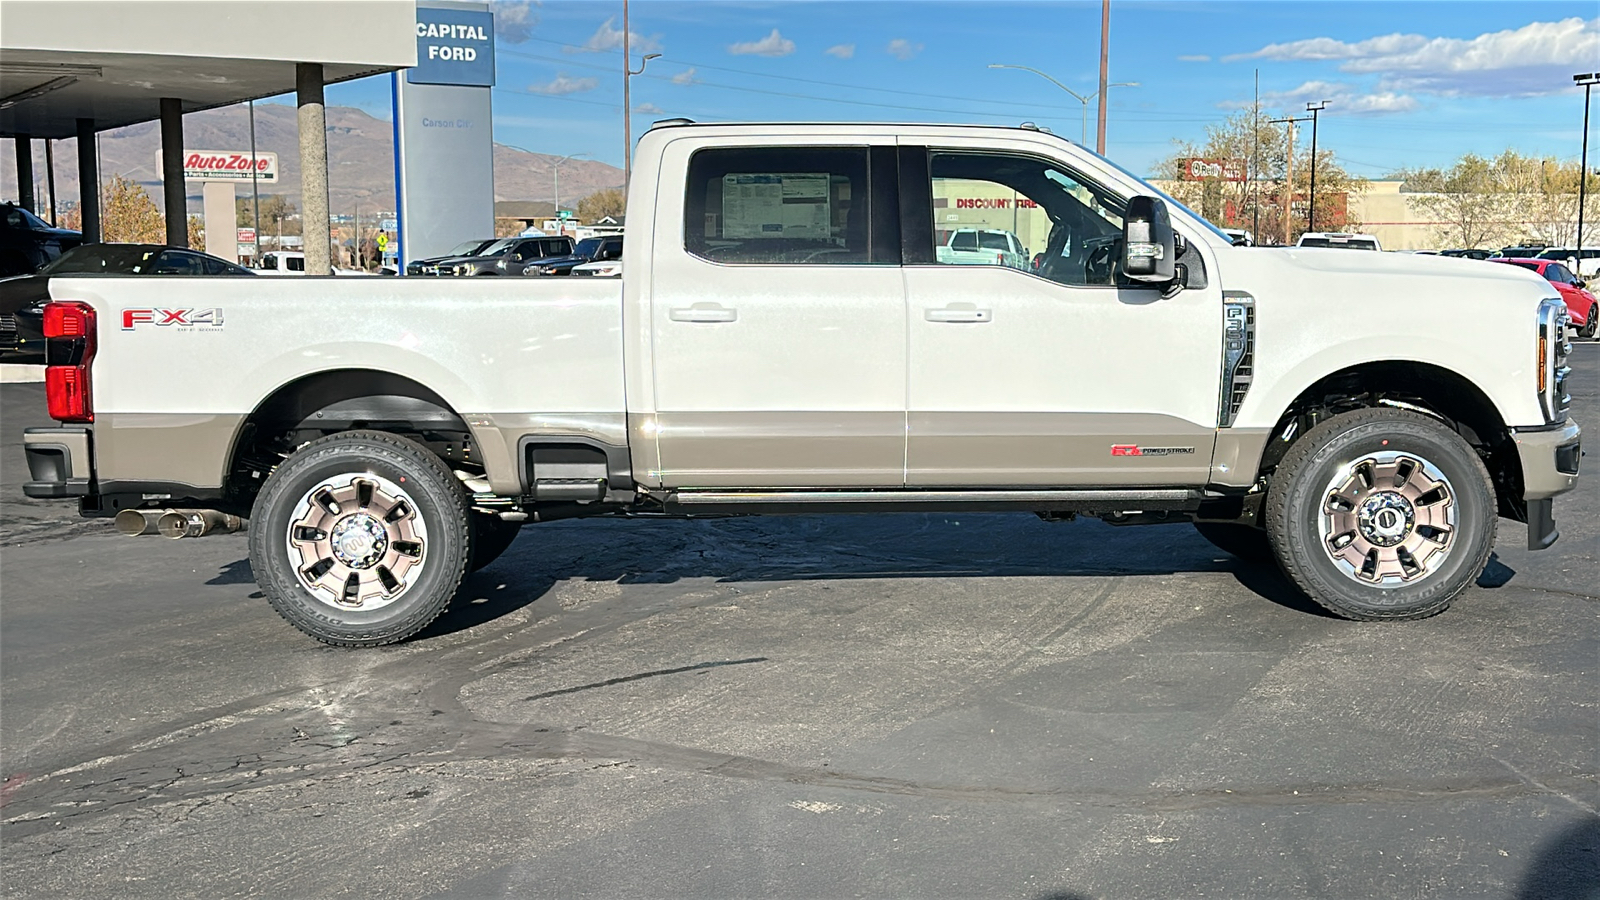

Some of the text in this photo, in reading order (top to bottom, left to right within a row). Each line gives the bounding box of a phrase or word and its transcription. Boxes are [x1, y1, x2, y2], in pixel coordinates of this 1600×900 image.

[416, 23, 488, 40] CAPITAL
[428, 45, 477, 61] FORD
[422, 118, 454, 128] Carson
[186, 154, 268, 170] AutoZone
[956, 198, 1037, 208] DISCOUNT TIRE
[121, 308, 224, 331] FX4
